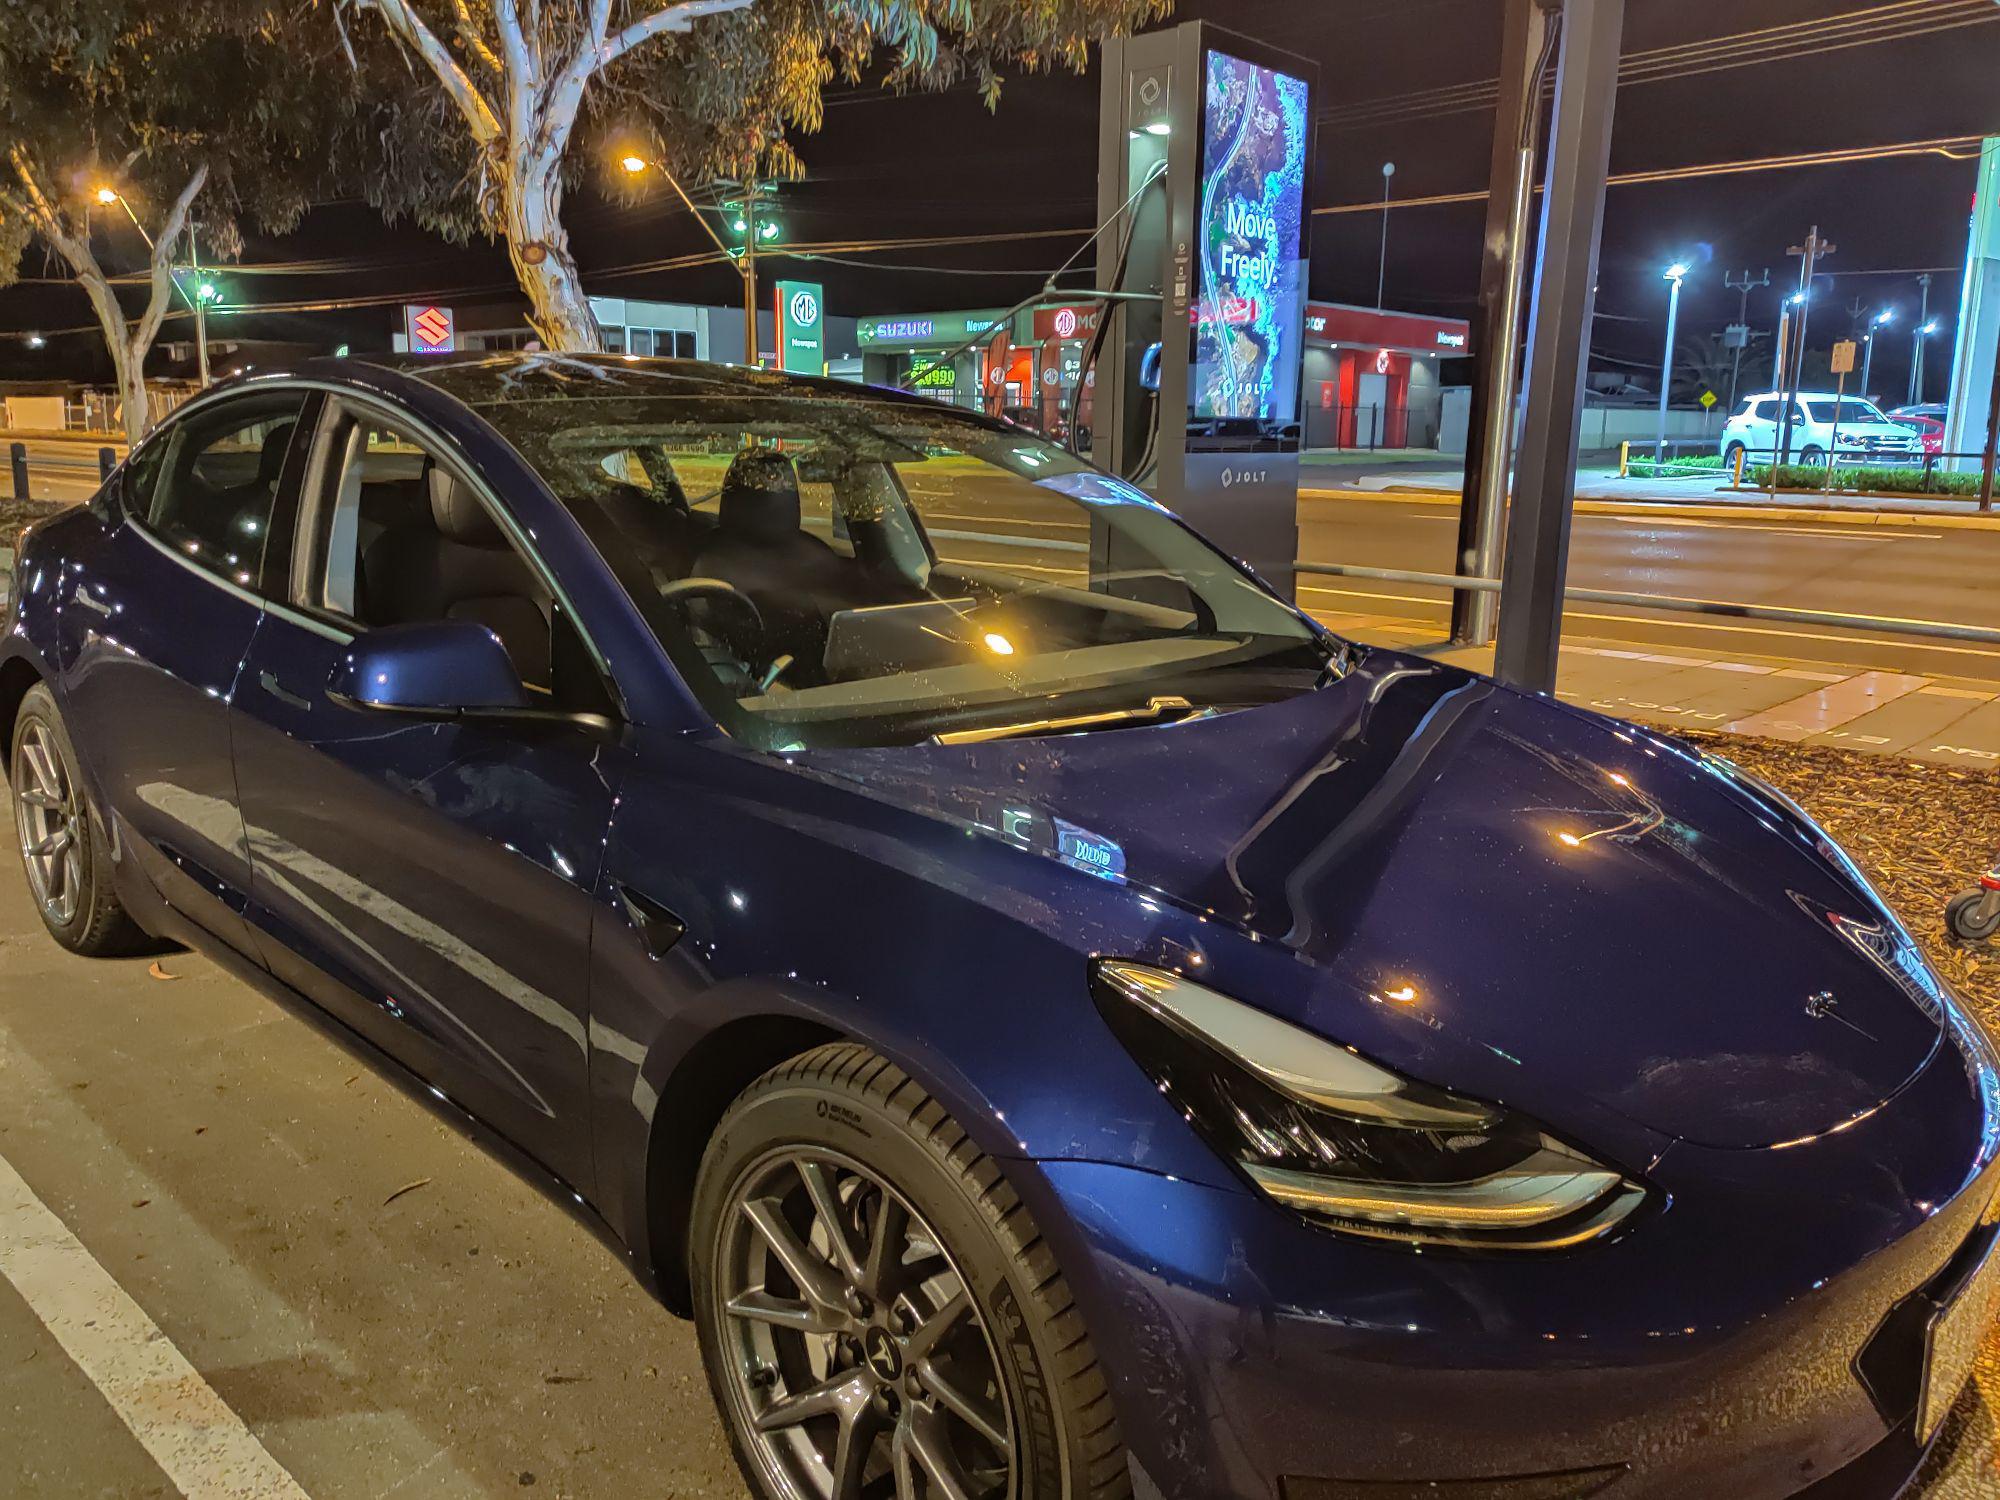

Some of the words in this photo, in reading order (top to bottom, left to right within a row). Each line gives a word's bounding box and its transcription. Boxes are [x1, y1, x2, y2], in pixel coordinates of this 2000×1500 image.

[1227, 202, 1276, 239] Move
[1220, 245, 1278, 289] Freely.
[876, 320, 934, 338] SUZUKI
[1237, 382, 1268, 397] JOLT
[1235, 470, 1268, 484] JOLT
